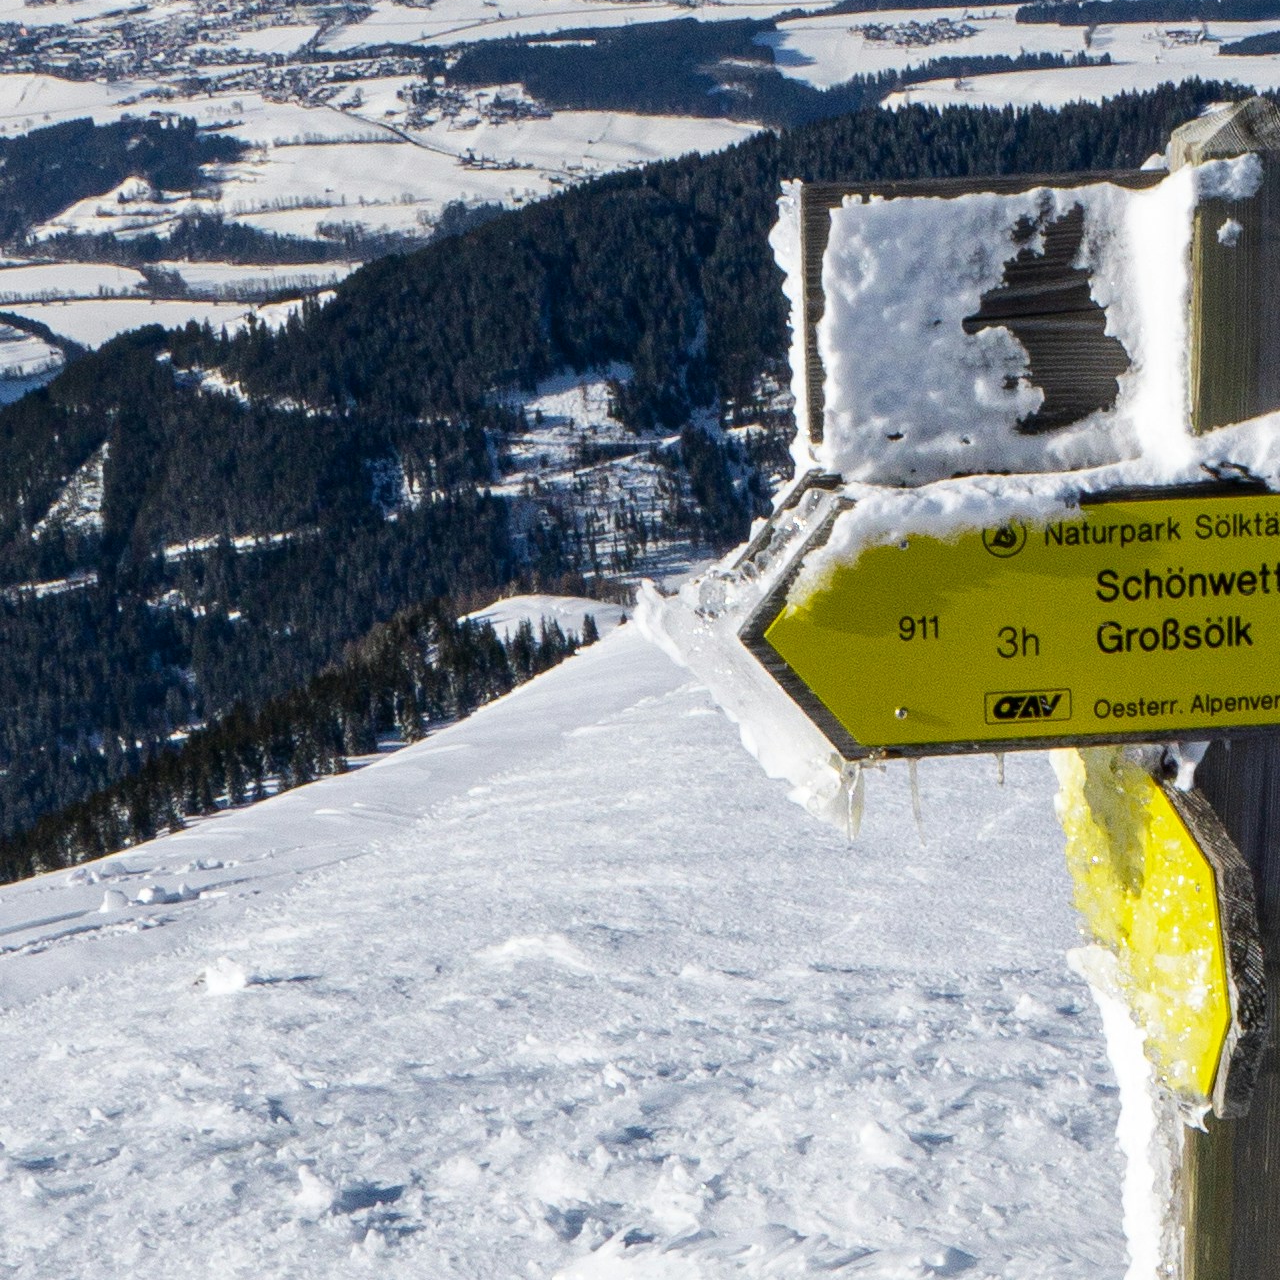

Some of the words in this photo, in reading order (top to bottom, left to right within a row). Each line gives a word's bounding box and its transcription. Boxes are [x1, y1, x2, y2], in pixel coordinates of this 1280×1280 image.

[1045, 517, 1181, 547] Naturpark
[899, 615, 940, 641] 911
[996, 626, 1040, 658] 3h
[1096, 616, 1254, 654] Großsölk
[1093, 697, 1184, 719] Oesterr.
